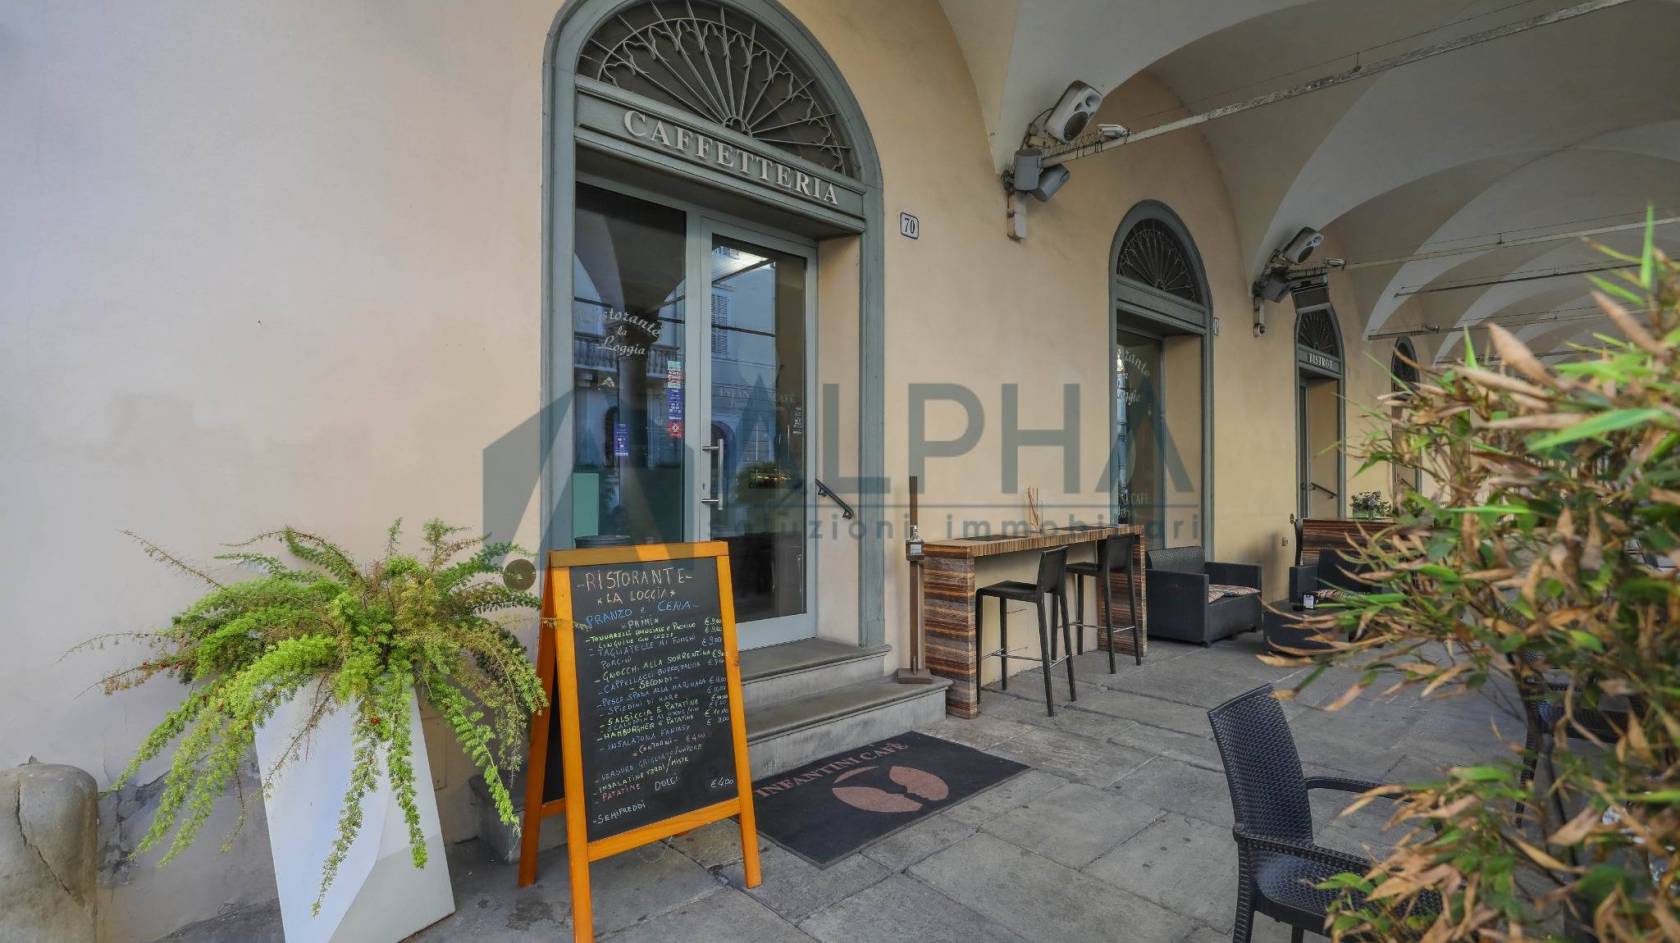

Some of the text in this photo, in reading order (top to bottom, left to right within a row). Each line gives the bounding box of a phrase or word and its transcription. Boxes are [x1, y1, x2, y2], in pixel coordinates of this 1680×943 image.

[624, 110, 838, 205] CAFFETTERIA
[904, 217, 915, 234] 70
[597, 335, 646, 357] Loggia
[606, 592, 623, 605] LA
[586, 608, 632, 626] PRANZO
[657, 599, 691, 612] CENA
[643, 659, 663, 670] ALLA
[656, 706, 662, 714] E
[755, 757, 862, 798] INFANTINI
